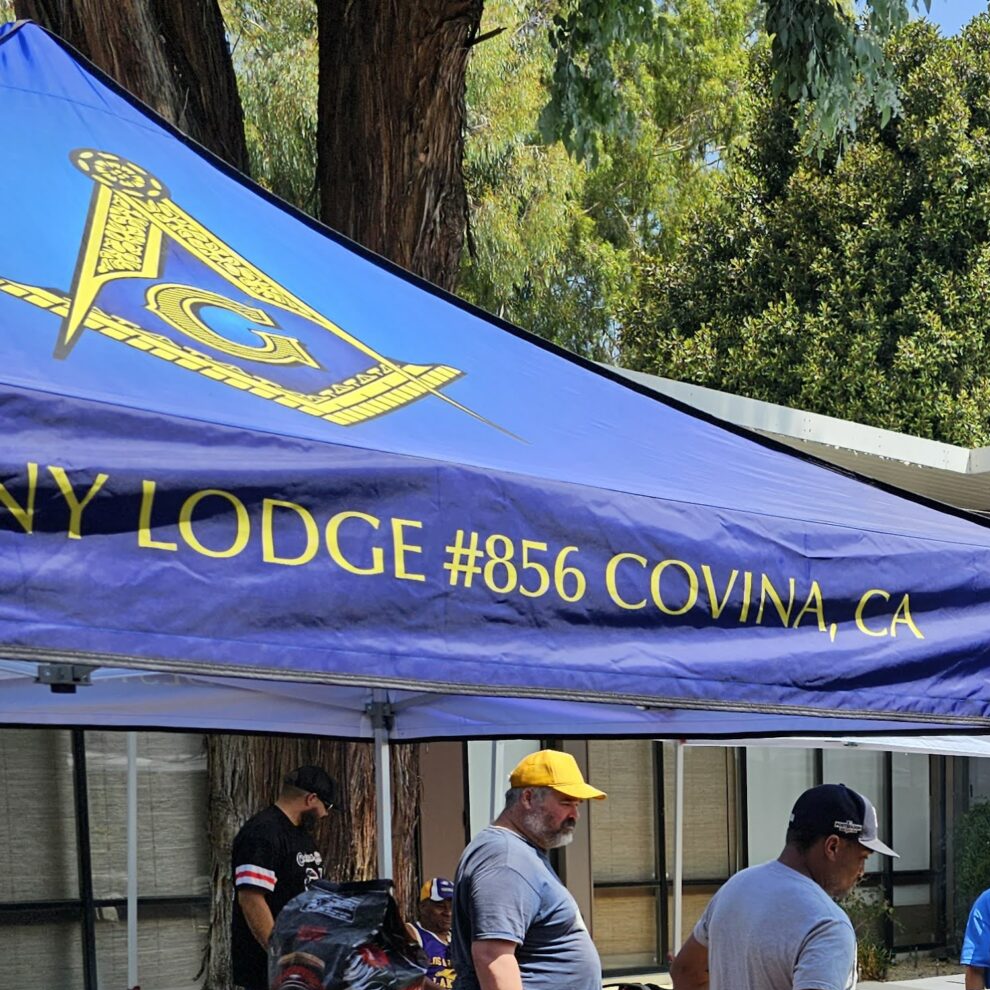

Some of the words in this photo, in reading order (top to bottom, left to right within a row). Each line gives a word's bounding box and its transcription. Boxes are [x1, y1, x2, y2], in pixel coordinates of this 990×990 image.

[138, 480, 426, 582] LODGE
[443, 529, 587, 602] #856
[605, 552, 838, 642] COVINA,
[854, 589, 924, 640] CA
